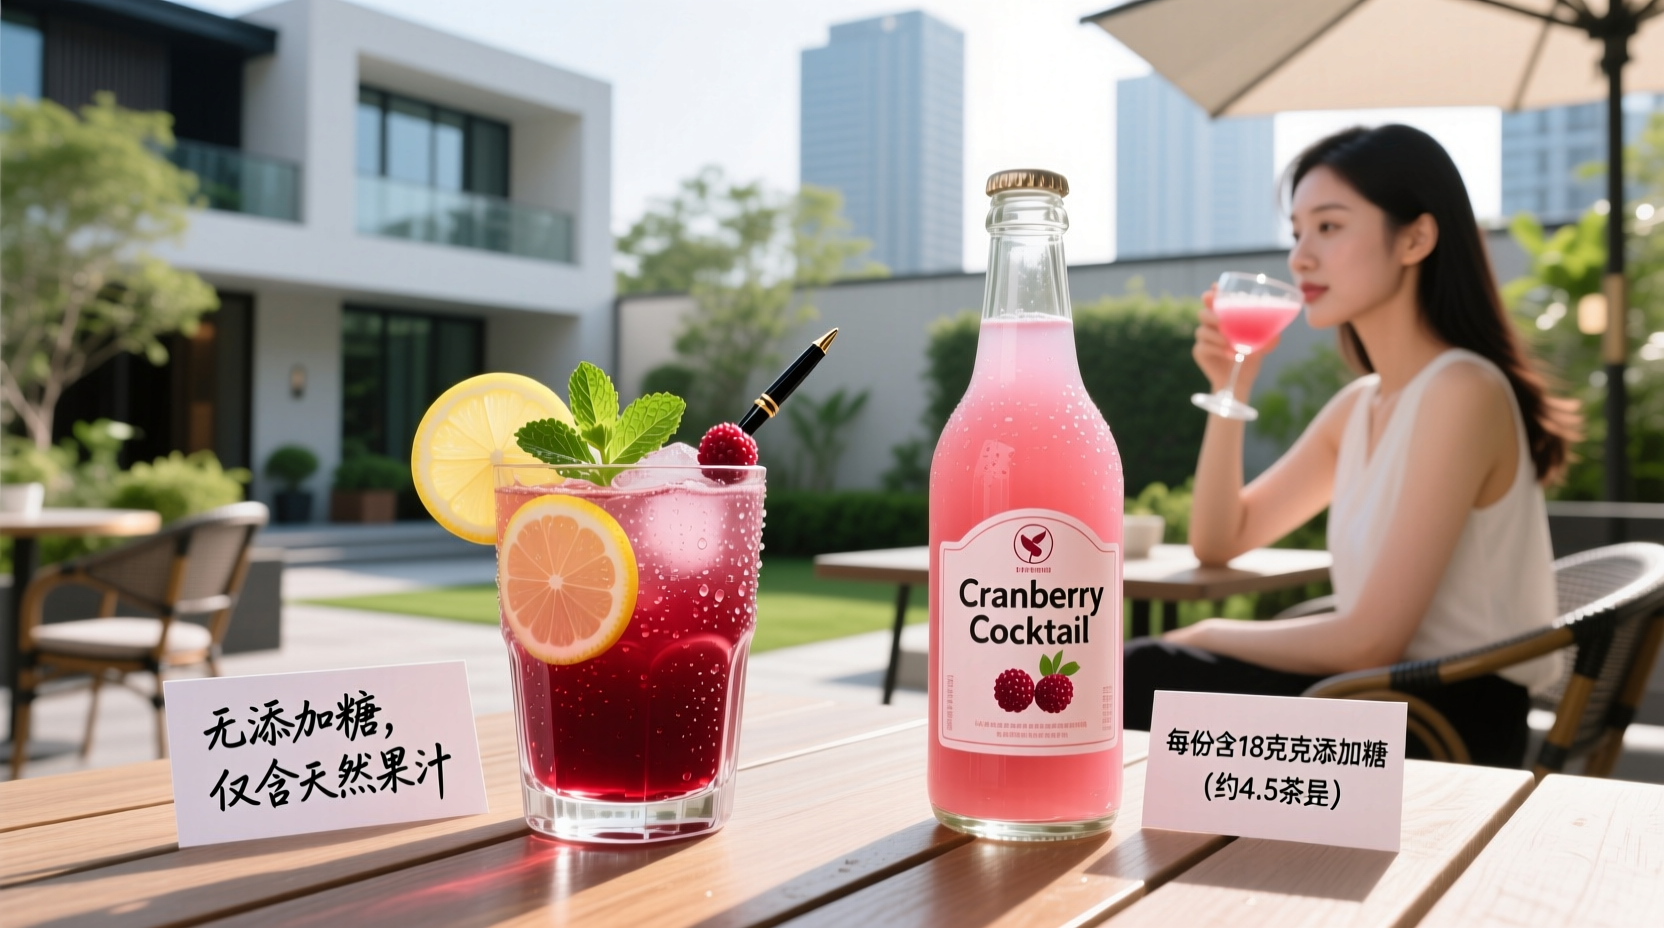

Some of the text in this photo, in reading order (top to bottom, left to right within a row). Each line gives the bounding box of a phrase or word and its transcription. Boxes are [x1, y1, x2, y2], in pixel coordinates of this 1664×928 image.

[959, 578, 1104, 616] Cranberry
[969, 615, 1089, 645] Cocktail
[203, 689, 394, 751] 无添加糖,
[1166, 727, 1389, 769] 每份含18克克添加糖
[209, 742, 452, 812] 仅含天然果汁
